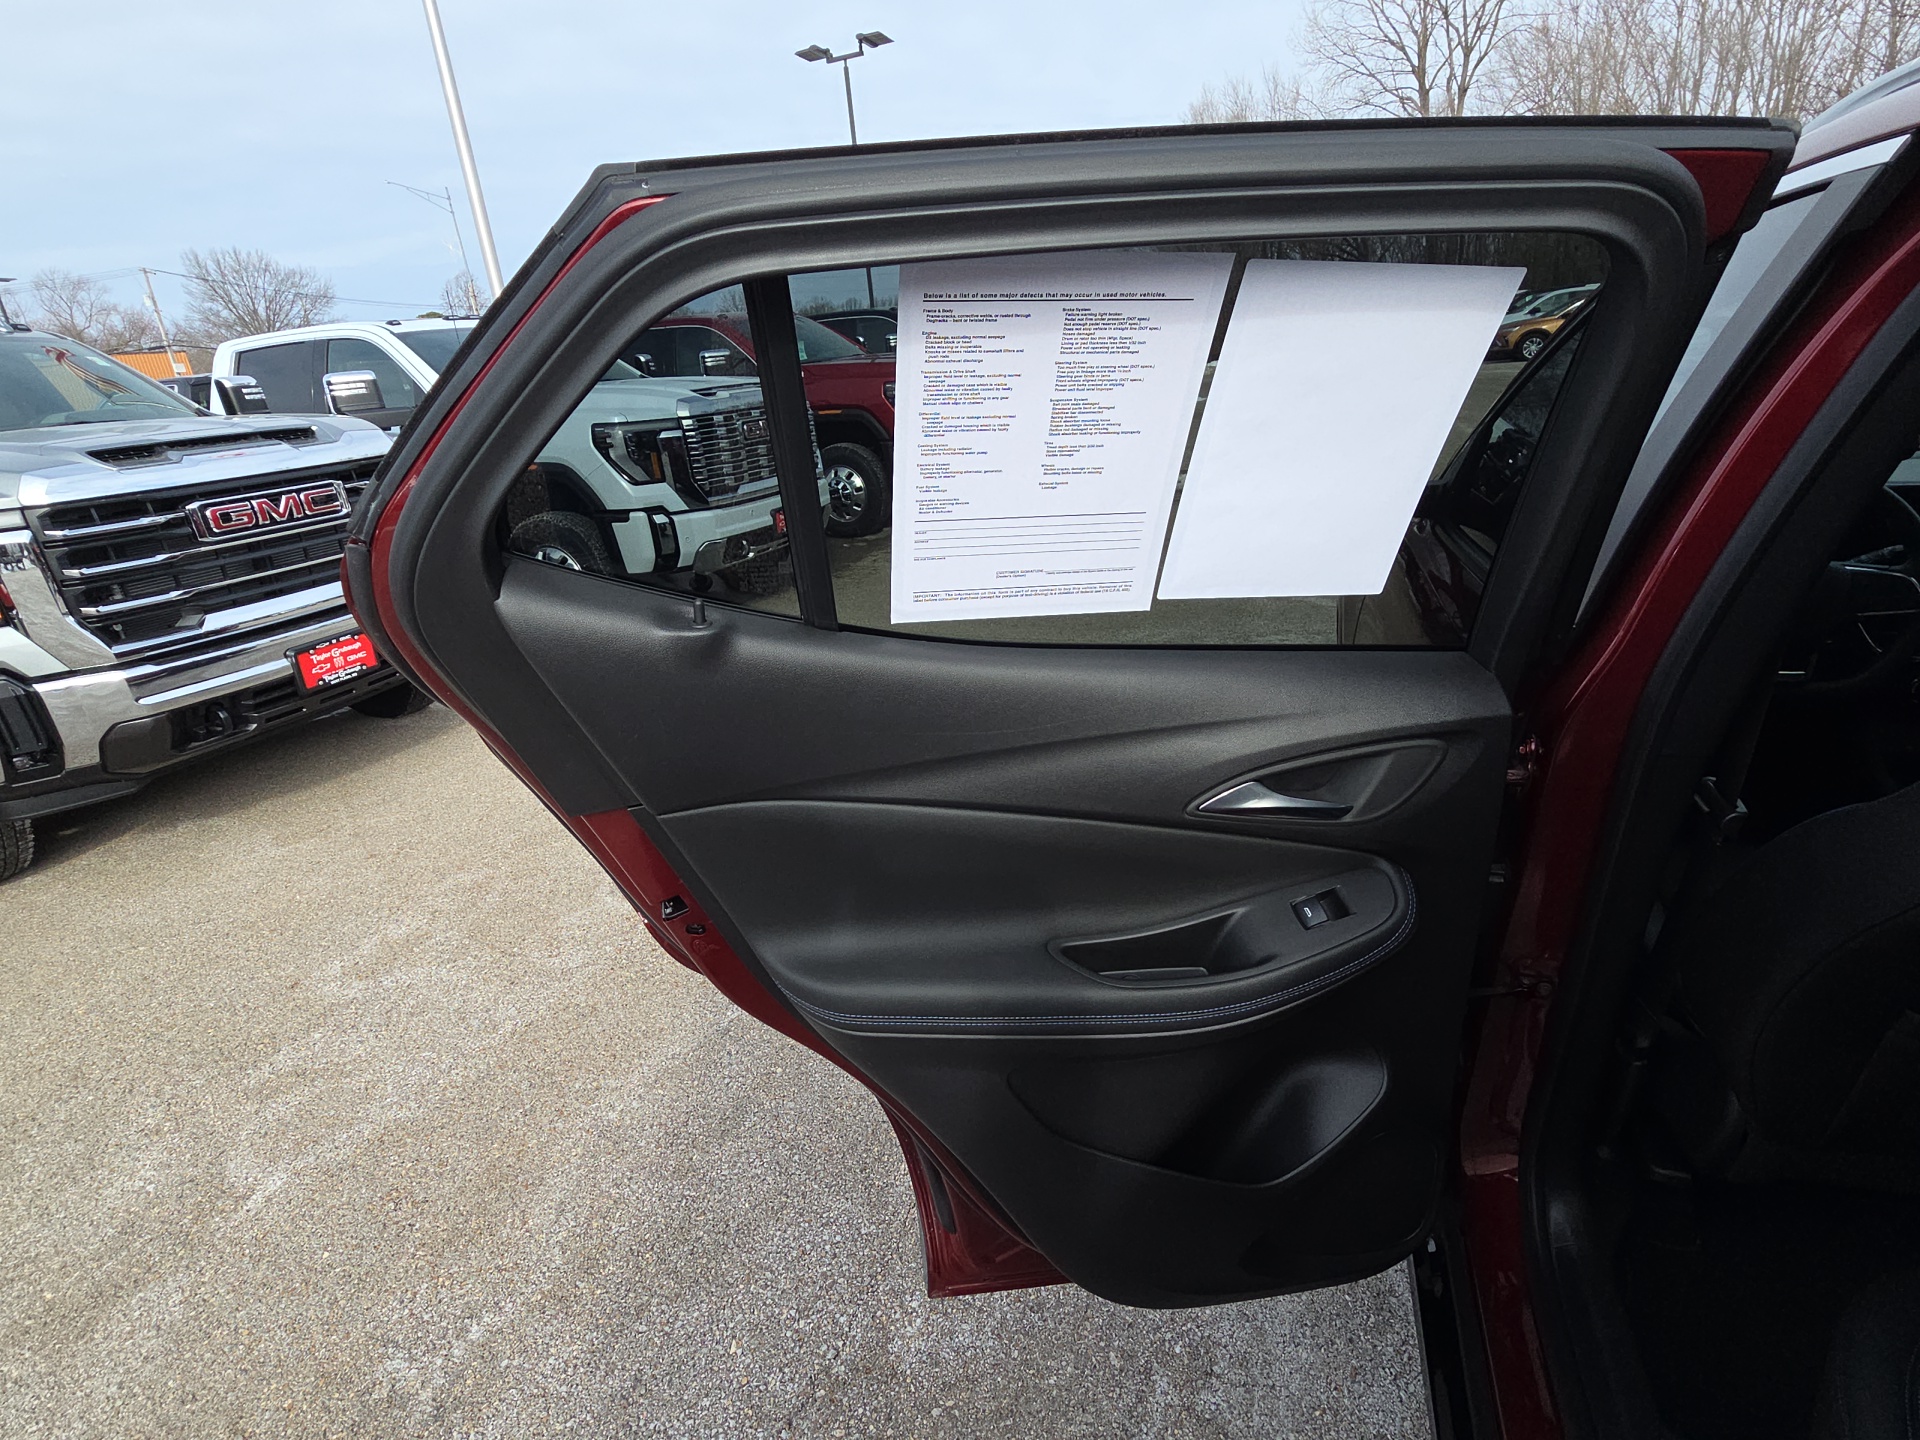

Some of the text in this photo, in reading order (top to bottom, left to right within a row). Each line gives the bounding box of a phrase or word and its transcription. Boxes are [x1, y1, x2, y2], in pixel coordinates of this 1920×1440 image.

[206, 488, 341, 532] GMC
[310, 652, 331, 664] Taylor
[347, 651, 366, 662] GMC
